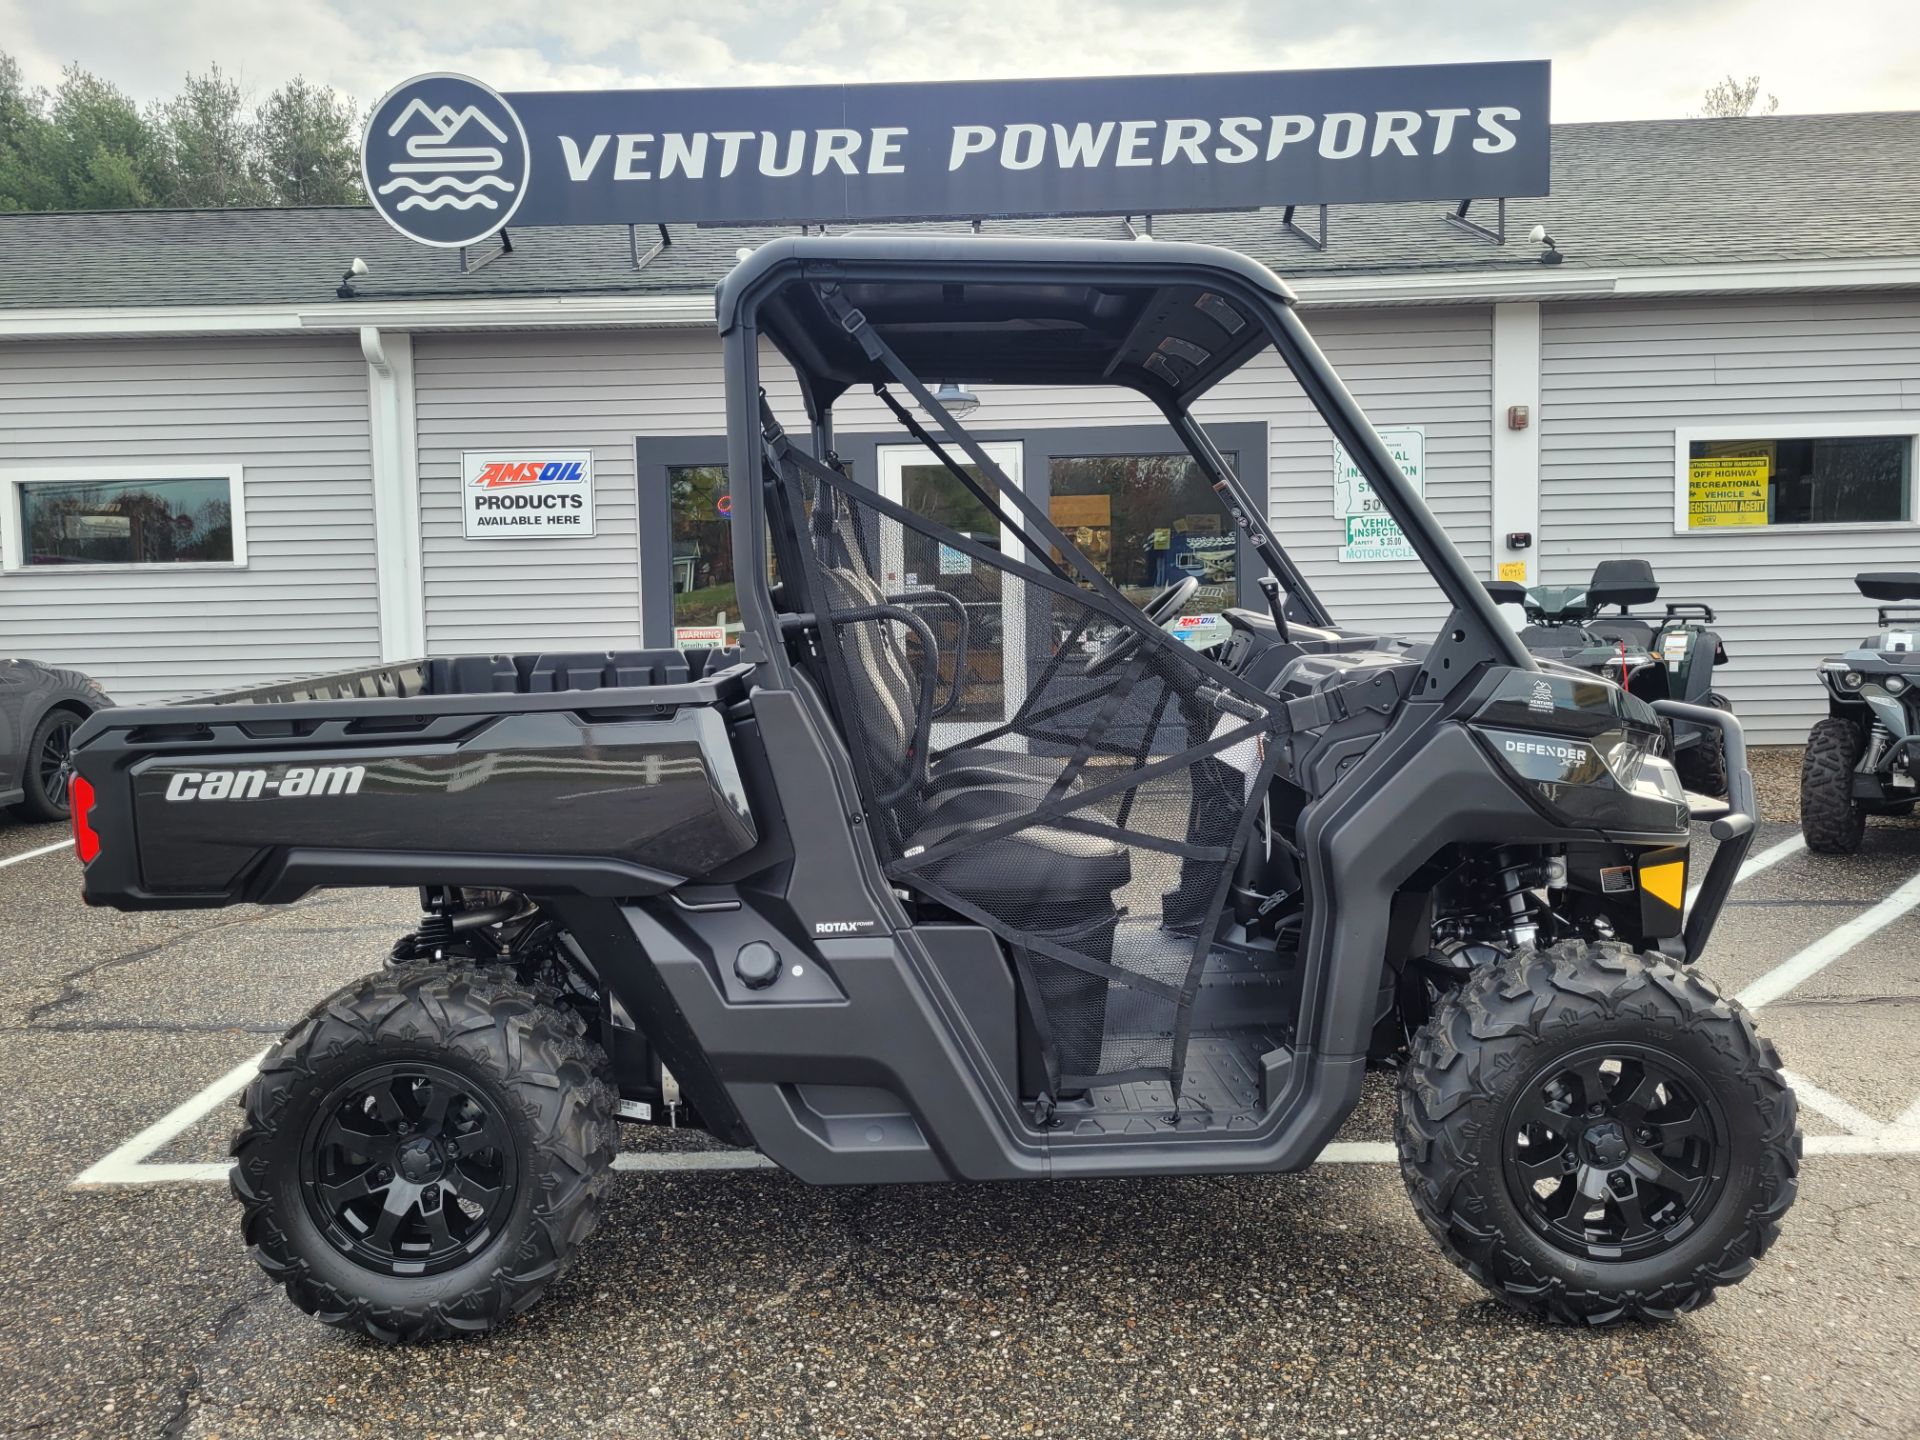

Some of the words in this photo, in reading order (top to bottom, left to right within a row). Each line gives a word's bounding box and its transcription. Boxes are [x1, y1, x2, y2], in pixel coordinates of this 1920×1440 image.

[558, 127, 908, 181] VENTURE
[948, 107, 1521, 171] POWERSPORTS
[474, 462, 584, 488] AMSOIL
[1693, 470, 1712, 478] OFF
[1714, 469, 1757, 478] HIGHWAY
[1690, 480, 1761, 489] RECREATIONAL
[1705, 490, 1745, 498] VEHICLE
[475, 494, 583, 510] PRODUCTS
[1689, 501, 1738, 513] EGISTRATION
[1739, 501, 1765, 512] AGENT
[477, 516, 542, 526] AVAILABLE
[547, 515, 581, 525] HERE
[1361, 518, 1396, 528] VEHIC
[1354, 527, 1404, 537] INSPECTIO
[1346, 548, 1415, 559] MOTORCYCLE
[1180, 616, 1216, 626] AMSOIL
[680, 630, 721, 639] WARNING
[1505, 740, 1587, 761] DEFENDER
[1559, 758, 1586, 768] XT
[165, 765, 366, 801] can-am
[815, 922, 857, 933] ROTAX
